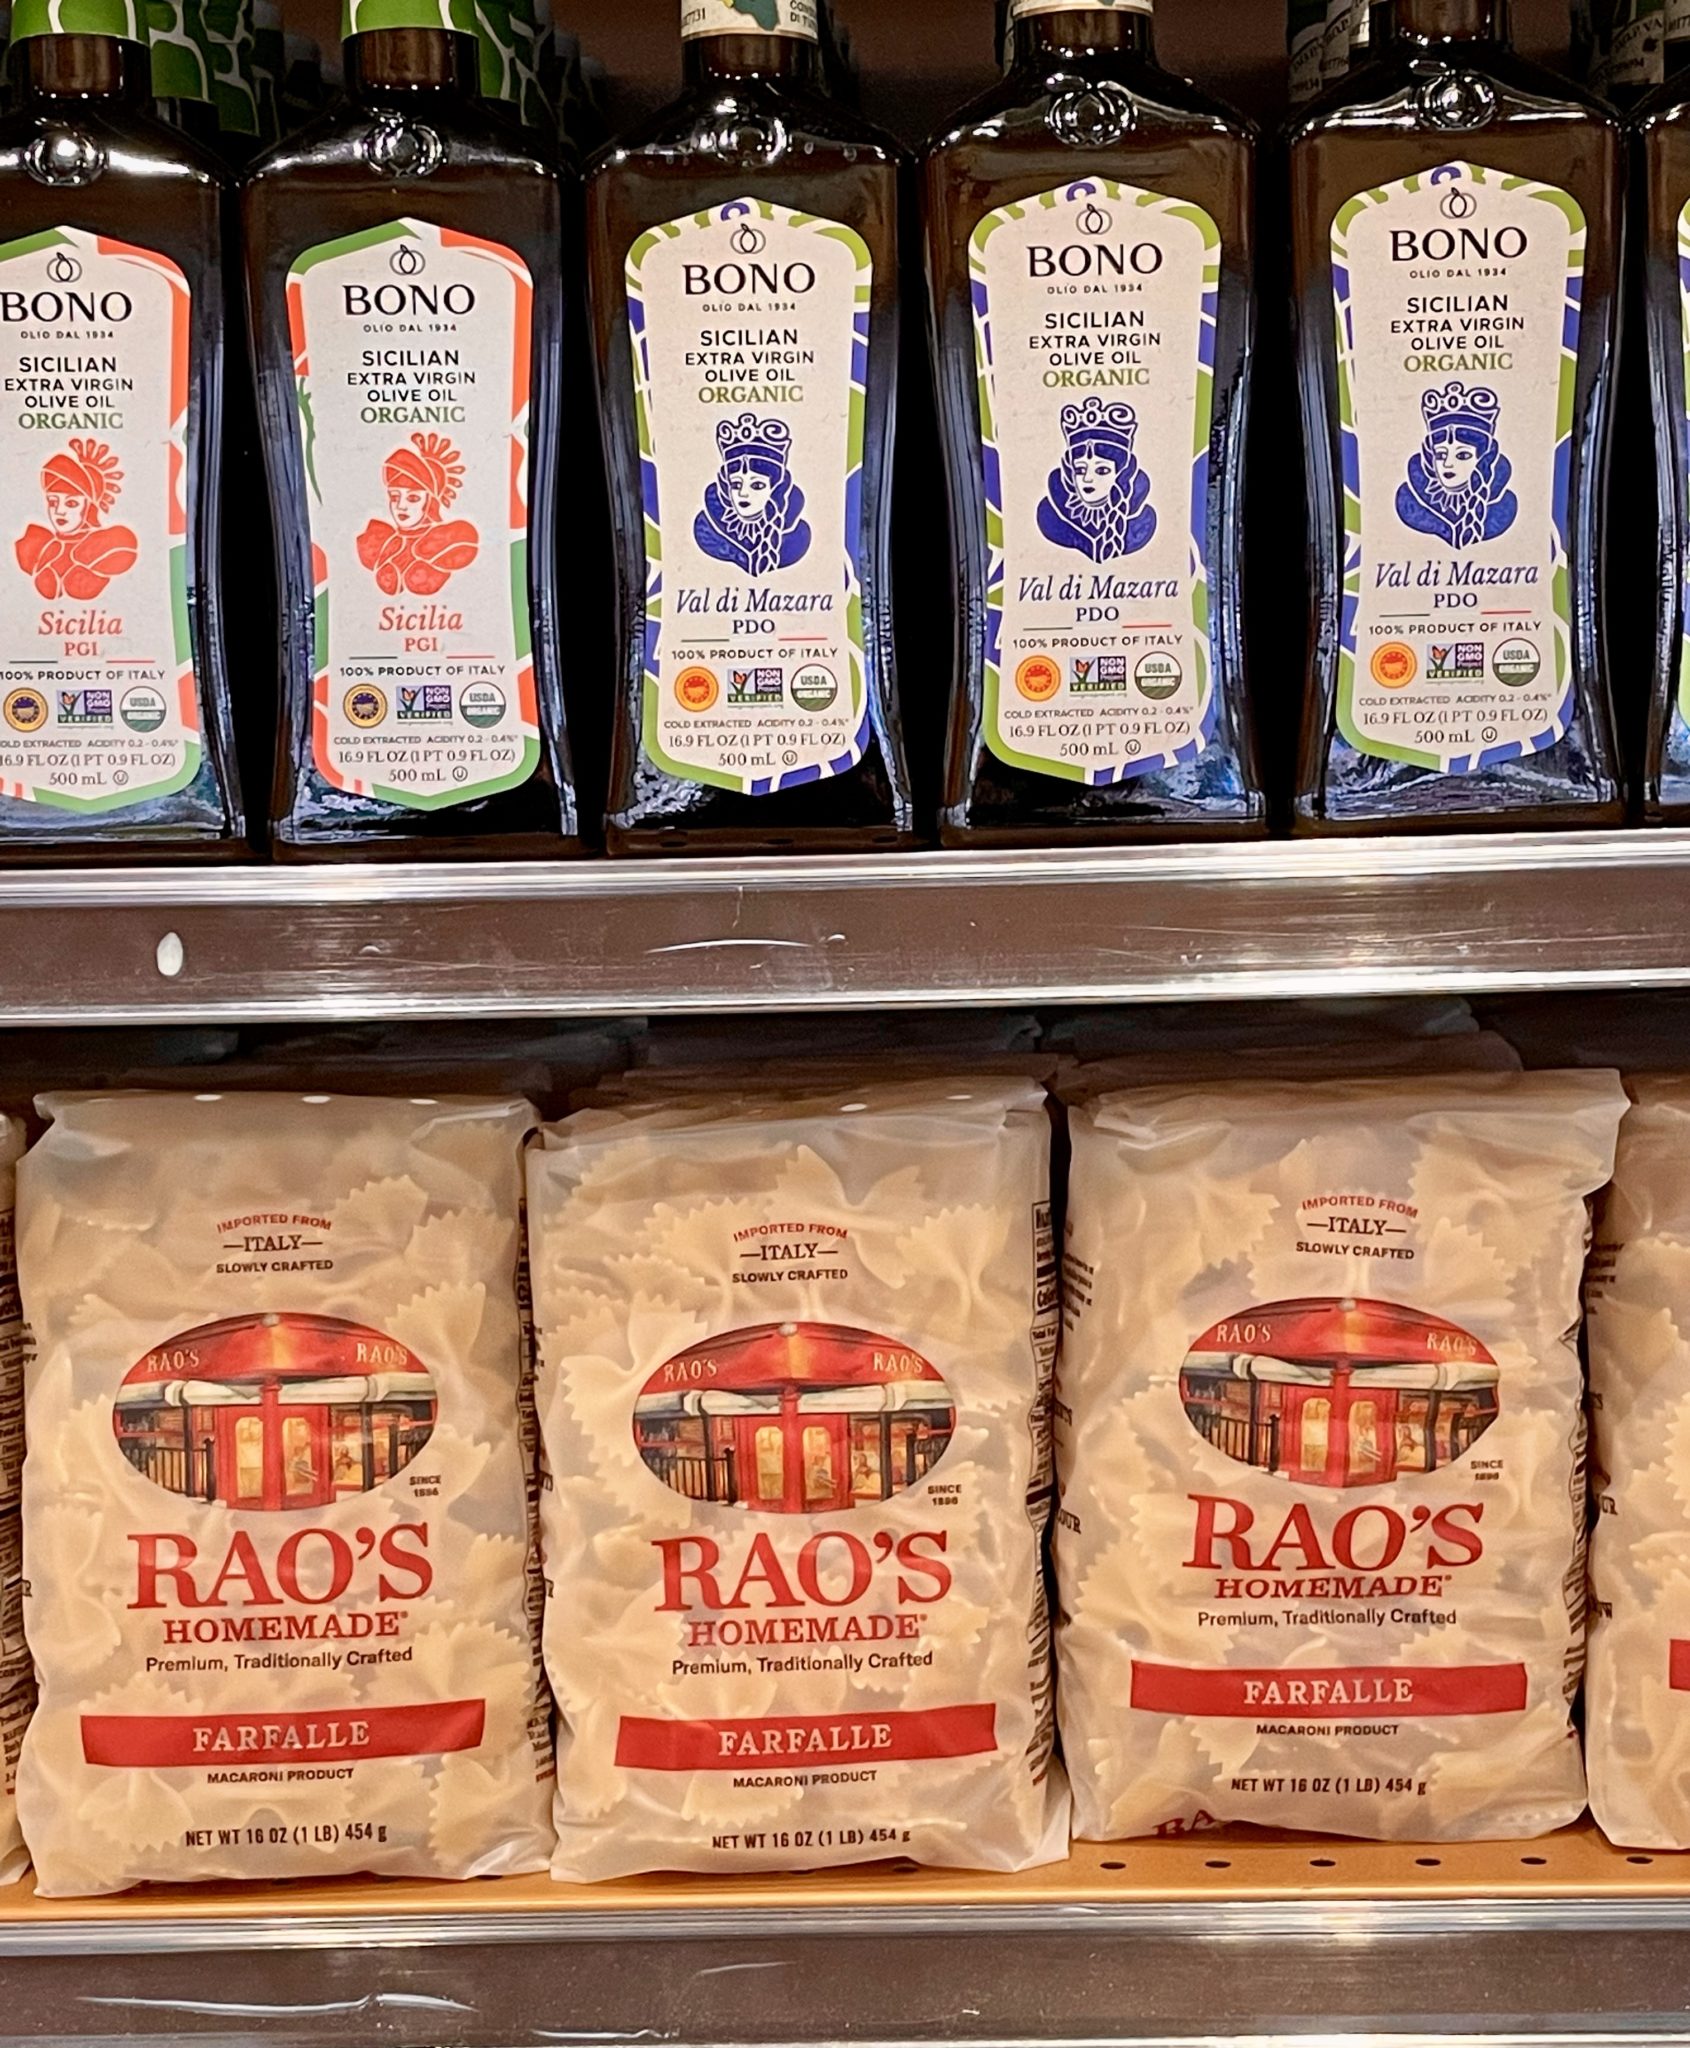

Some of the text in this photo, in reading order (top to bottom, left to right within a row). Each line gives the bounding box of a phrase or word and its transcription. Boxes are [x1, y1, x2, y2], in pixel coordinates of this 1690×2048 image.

[1390, 227, 1527, 261] BONO
[1027, 243, 1162, 277] BONO
[682, 263, 815, 295] BONO
[1410, 268, 1506, 278] OLIO DAL 1934
[1047, 284, 1142, 294] OLIO DAL 1934
[0, 292, 132, 322] BONO
[343, 284, 474, 315] BONO
[703, 303, 795, 312] OLIO DAL 1934
[1408, 295, 1507, 313] SICILIAN
[363, 324, 393, 332] OLIO
[399, 324, 422, 332] DAL
[1046, 311, 1143, 329] SICILIAN
[1391, 317, 1524, 333] EXTRA VIRGIN
[21, 331, 50, 339] OLIO
[56, 331, 79, 339] DAL
[701, 329, 797, 346] SICILIAN
[1030, 333, 1160, 349] EXTRA VIRGIN
[1411, 336, 1505, 350] OLIVE OIL
[20, 357, 116, 372] SICILIAN
[363, 350, 458, 366] SICILIAN
[686, 351, 813, 365] EXTRA VIRGIN
[1050, 351, 1142, 366] OLIVE OIL
[1404, 353, 1512, 372] ORGANIC
[348, 372, 475, 385] EXTRA VIRGIN
[705, 369, 795, 382] OLIVE OIL
[1043, 369, 1149, 387] ORGANIC
[5, 379, 132, 391] EXTRA VIRGIN
[25, 396, 114, 408] OLIVE OIL
[368, 389, 456, 402] OLIVE OIL
[699, 385, 803, 403] ORGANIC
[19, 413, 122, 429] ORGANIC
[361, 407, 465, 423] ORGANIC
[1376, 560, 1538, 588] Val di Mazara
[1019, 574, 1178, 601] Val di Mazara
[677, 587, 832, 613] Val di Mazara
[1434, 593, 1477, 608] PDO
[379, 605, 462, 630] Sicilia
[1077, 607, 1119, 621] PDO
[38, 610, 122, 635] Sicilia
[733, 619, 775, 634] PDO
[1370, 622, 1541, 635] 100% PRODUCT OF ITALY
[65, 642, 97, 656] PGI
[405, 637, 437, 652] PGI
[672, 648, 837, 659] 100% PRODUCT OF ITALY
[1060, 742, 1118, 756] 500 mL
[389, 769, 445, 782] 500 mL
[1302, 1196, 1417, 1218] IMPORTED FROM
[216, 1214, 332, 1234] IMPORTED FROM
[734, 1223, 848, 1242] IMPORTED FROM
[1296, 1241, 1414, 1259] SLOWLY CRAFTED
[217, 1260, 333, 1273] SLOWLY CRAFTED
[733, 1269, 848, 1283] SLOWLY CRAFTED
[1471, 1460, 1503, 1469] SINCE
[410, 1475, 441, 1485] SINCE
[928, 1485, 962, 1494] SINCE
[1182, 1493, 1483, 1572] RAO'S
[127, 1522, 432, 1610] RAO'S
[651, 1530, 952, 1612] RAO'S
[1199, 1608, 1456, 1627] Premium, Traditionally Crafted
[147, 1646, 412, 1672] Premium, Traditionally Crafted
[673, 1651, 932, 1674] Premium, Traditionally Crafted
[1244, 1679, 1412, 1704] FARFALLE
[193, 1721, 369, 1751] FARFALLE
[1256, 1725, 1399, 1735] MACARONI PRODUCT
[719, 1724, 891, 1755] FARFALLE
[207, 1768, 353, 1783] MACARONI PRODUCT
[734, 1770, 877, 1787] MACARONI PRODUCT
[1232, 1777, 1426, 1795] NET WT 16 OZ (1 LB) 454 g
[186, 1823, 387, 1847] NET WT 16 OZ (1 LB) 454 g
[713, 1829, 910, 1848] NET WT 16 OZ (1 LB) 454 g
